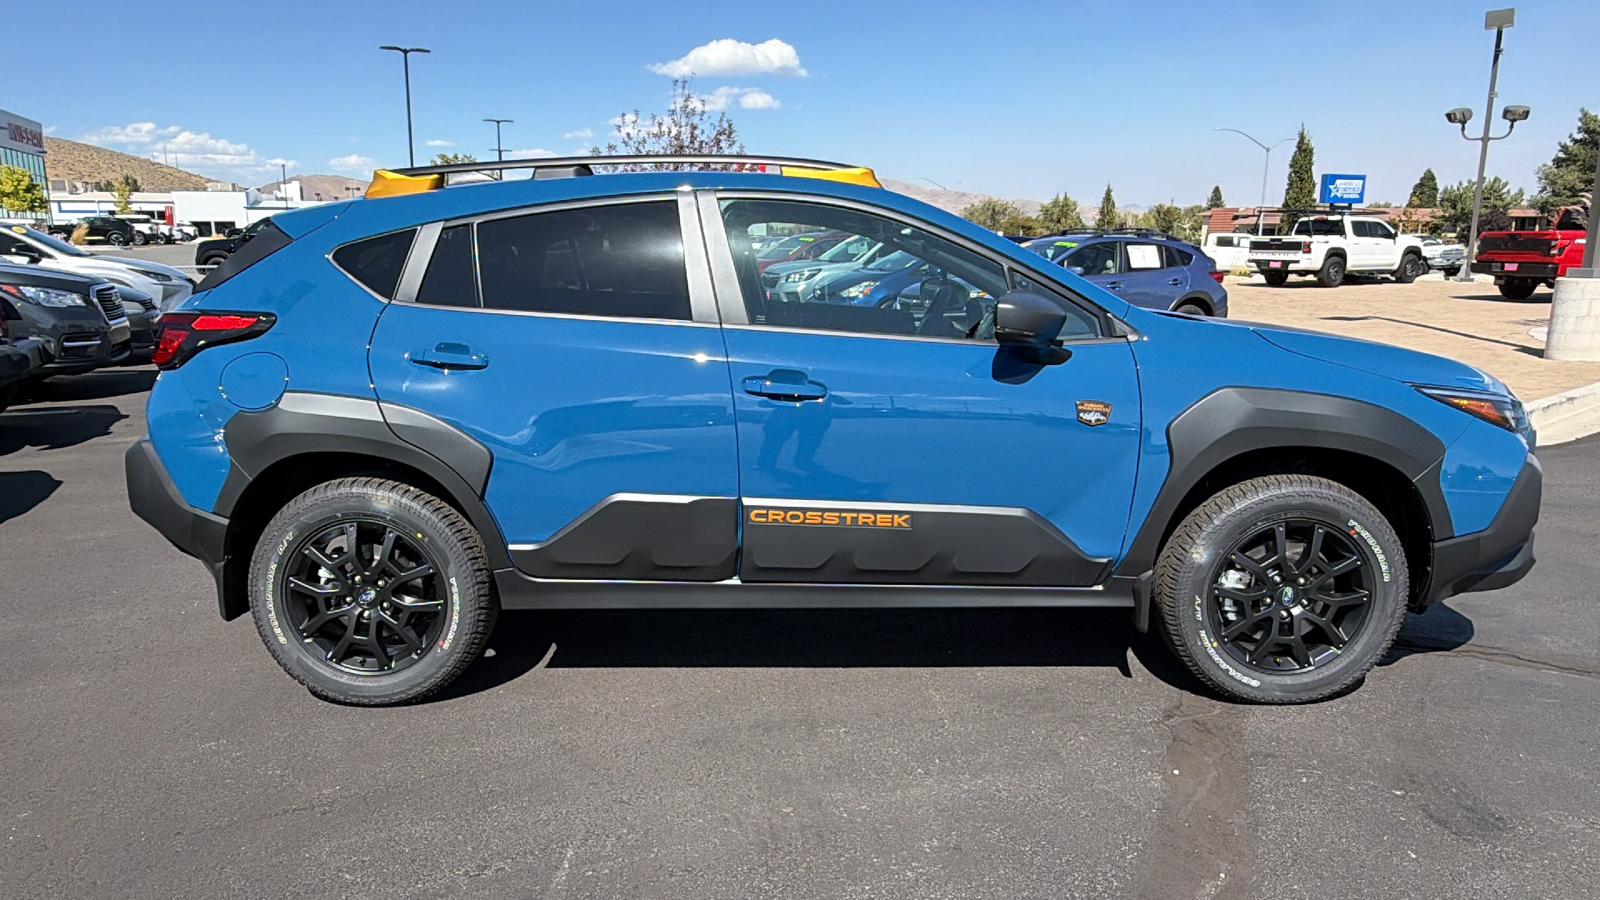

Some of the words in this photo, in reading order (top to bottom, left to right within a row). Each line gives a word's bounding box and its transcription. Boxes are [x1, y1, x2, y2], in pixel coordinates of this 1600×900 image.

[12, 124, 43, 148] NISSAN
[750, 509, 911, 528] CROSSTREK
[265, 561, 288, 645] GEOLANDAR
